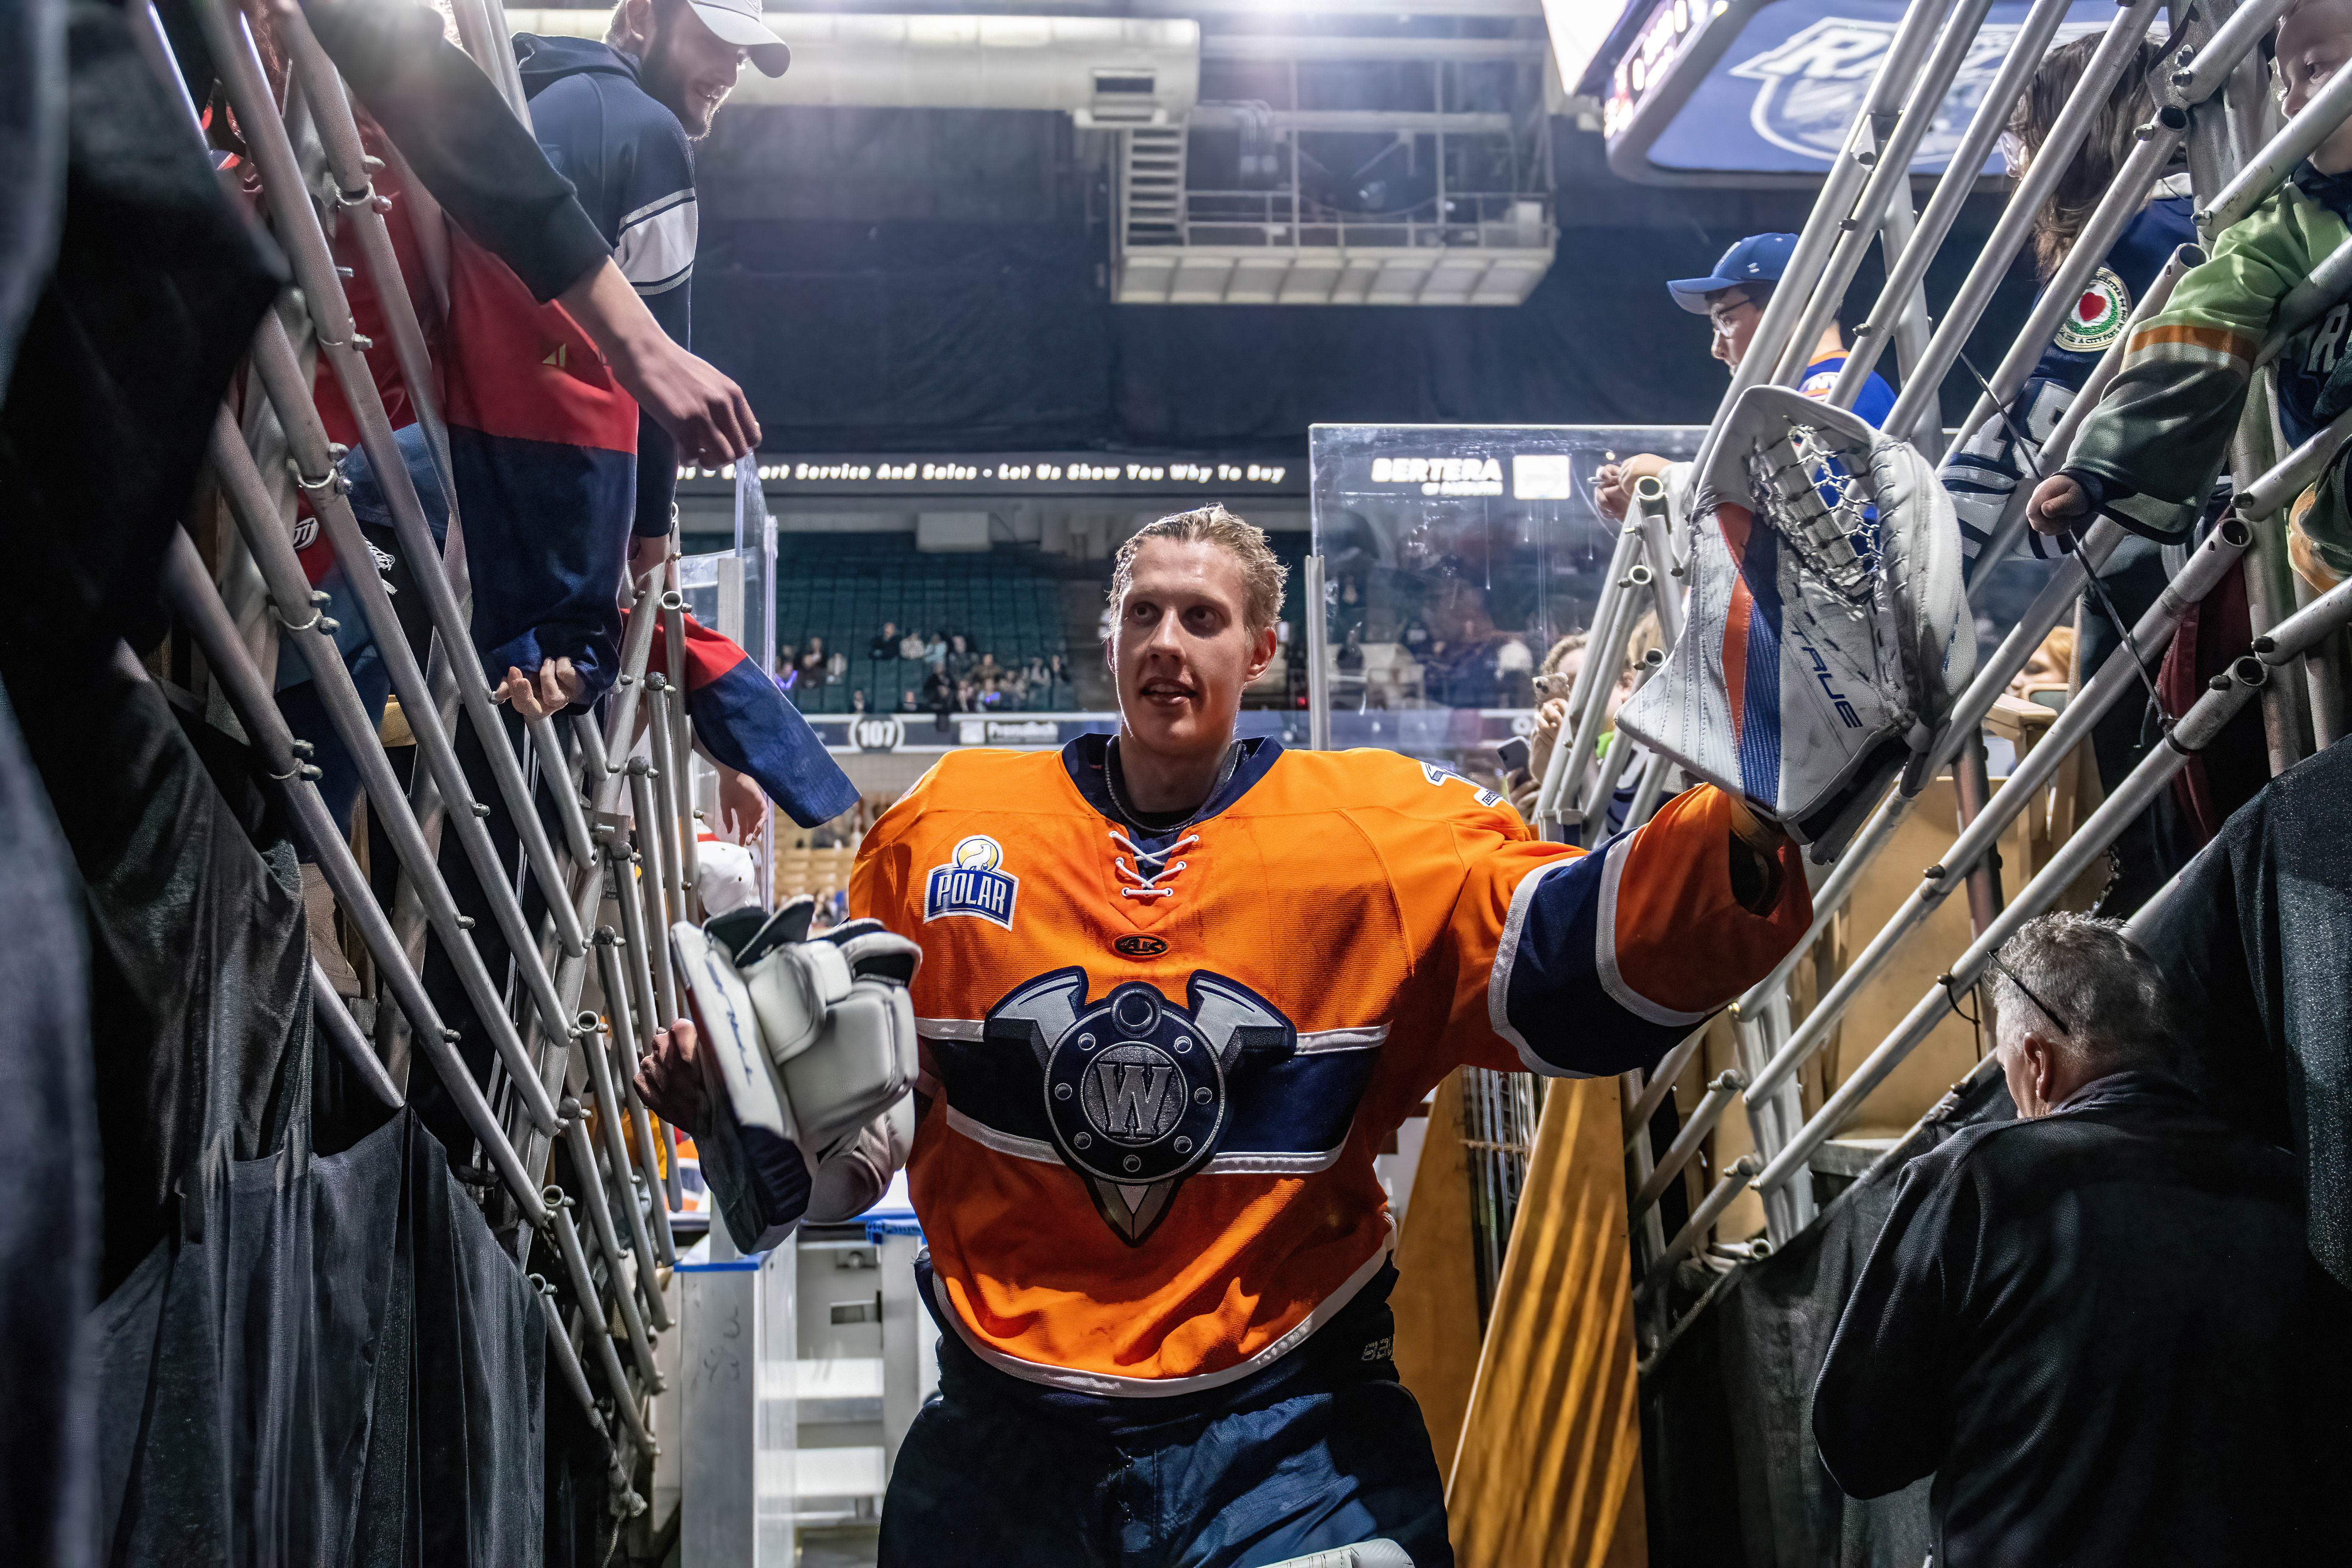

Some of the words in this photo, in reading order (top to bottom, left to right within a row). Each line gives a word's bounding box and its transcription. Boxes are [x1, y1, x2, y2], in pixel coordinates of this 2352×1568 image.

[795, 463, 871, 480] Service
[876, 463, 917, 480] And
[923, 463, 977, 480] Sales
[998, 463, 1031, 480] Let
[1036, 463, 1061, 480] Us
[1067, 463, 1120, 480] Show
[1126, 463, 1164, 480] You
[1170, 463, 1212, 483] Why
[1218, 464, 1242, 481] To
[1247, 464, 1285, 483] Buy
[1372, 458, 1503, 482] BERTERA
[1791, 621, 1863, 728] TRUE
[858, 721, 895, 747] 107
[936, 873, 1006, 915] POLAR
[1097, 1062, 1173, 1136] W
